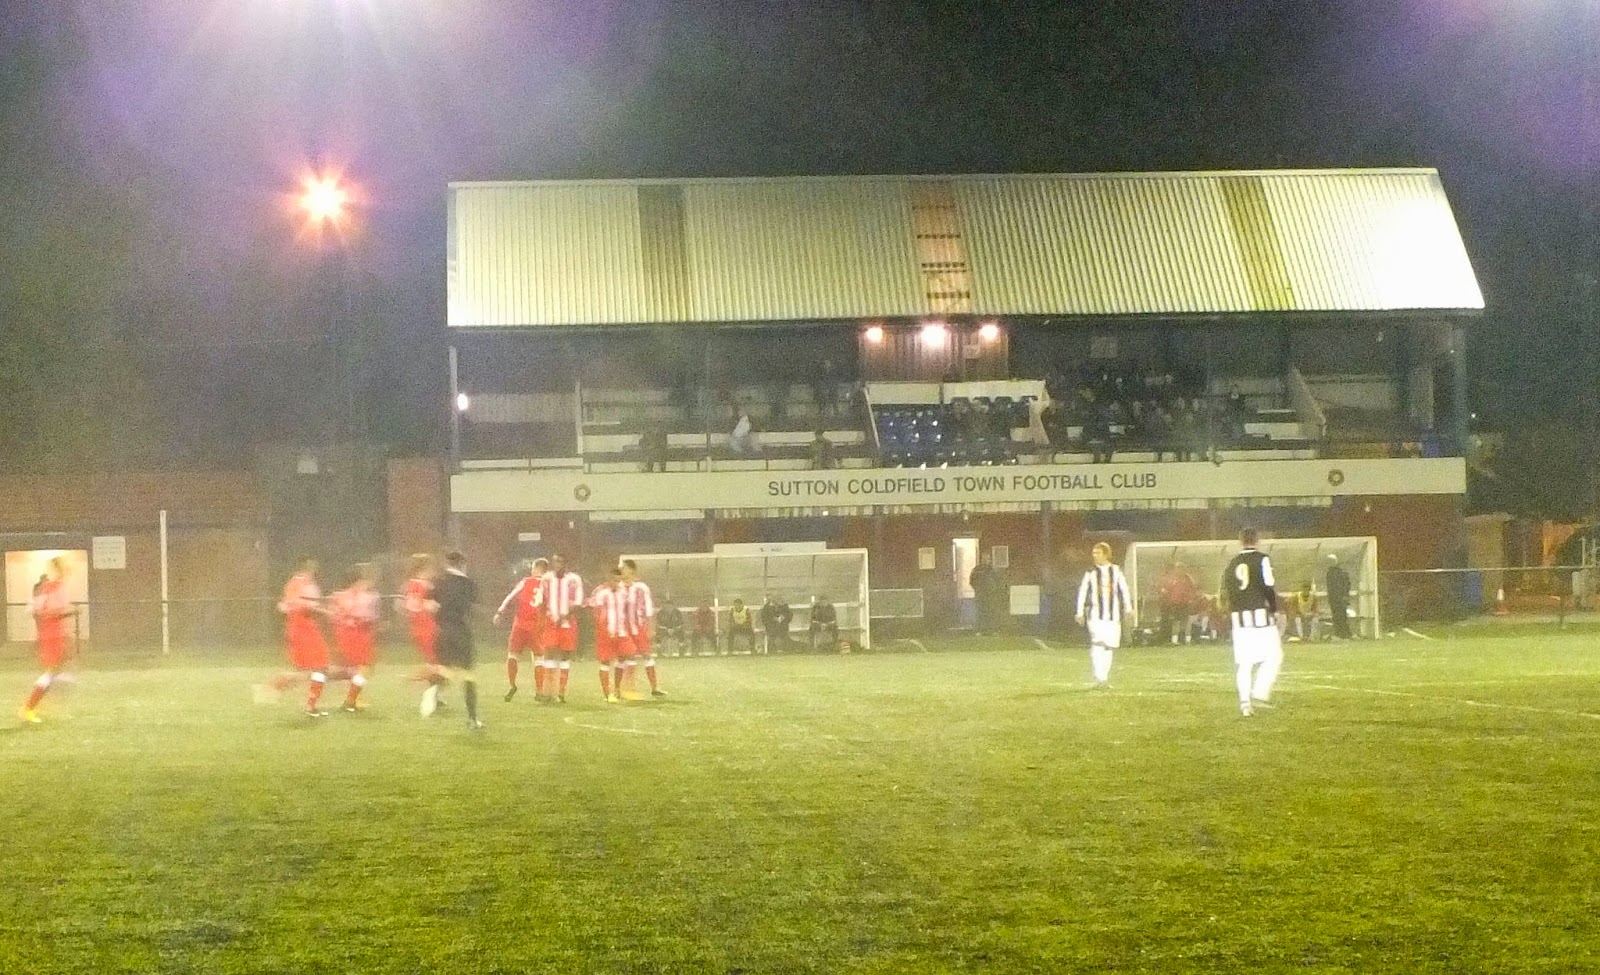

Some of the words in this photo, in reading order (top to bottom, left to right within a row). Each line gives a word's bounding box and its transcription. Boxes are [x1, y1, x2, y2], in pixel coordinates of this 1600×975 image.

[768, 480, 839, 496] SUTTON
[847, 478, 946, 494] COLDFIELD
[953, 476, 1005, 492] TOWN
[1013, 474, 1103, 490] FOOTBALL
[1111, 473, 1157, 489] CLUB
[1235, 563, 1249, 590] 9
